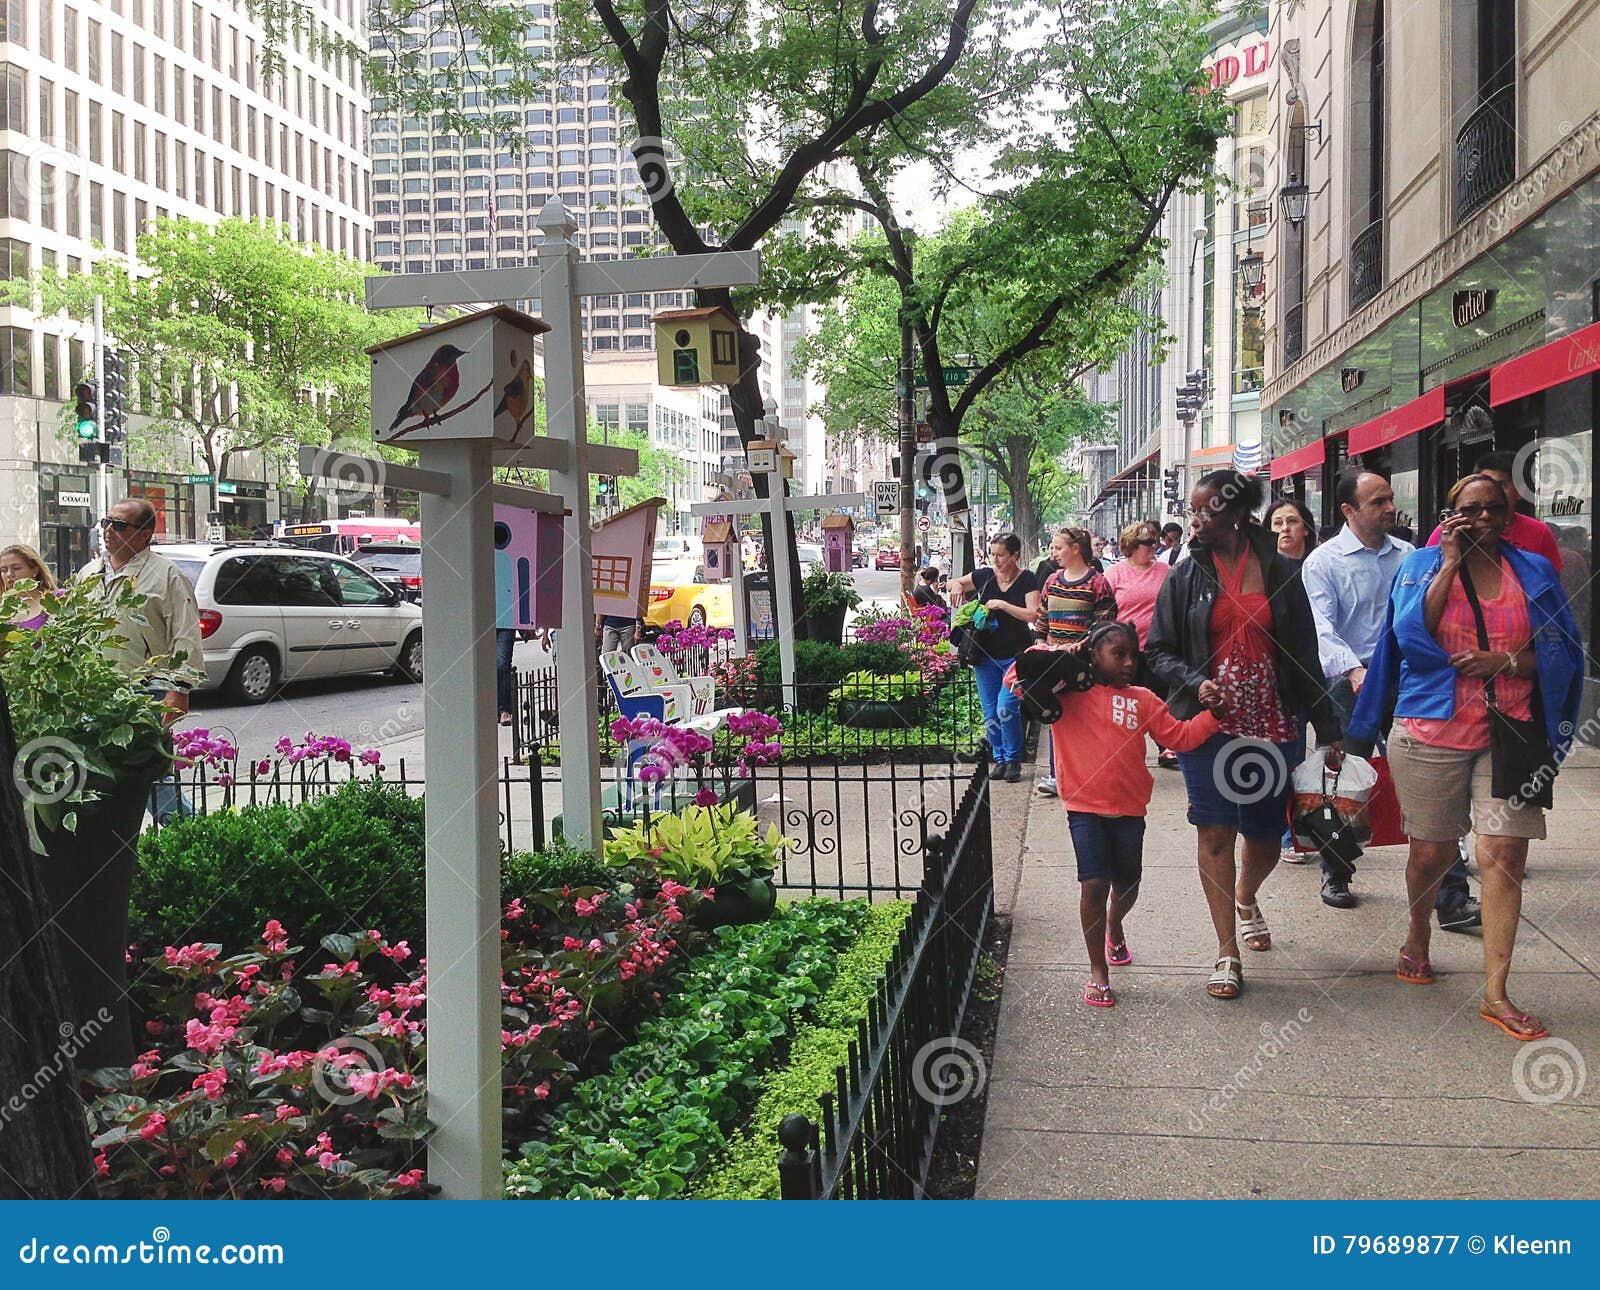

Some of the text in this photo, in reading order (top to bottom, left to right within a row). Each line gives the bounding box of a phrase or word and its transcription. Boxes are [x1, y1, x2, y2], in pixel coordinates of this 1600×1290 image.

[1451, 288, 1488, 329] Cartier
[877, 484, 897, 493] ONE
[61, 495, 89, 503] COACH
[877, 493, 897, 502] WAY
